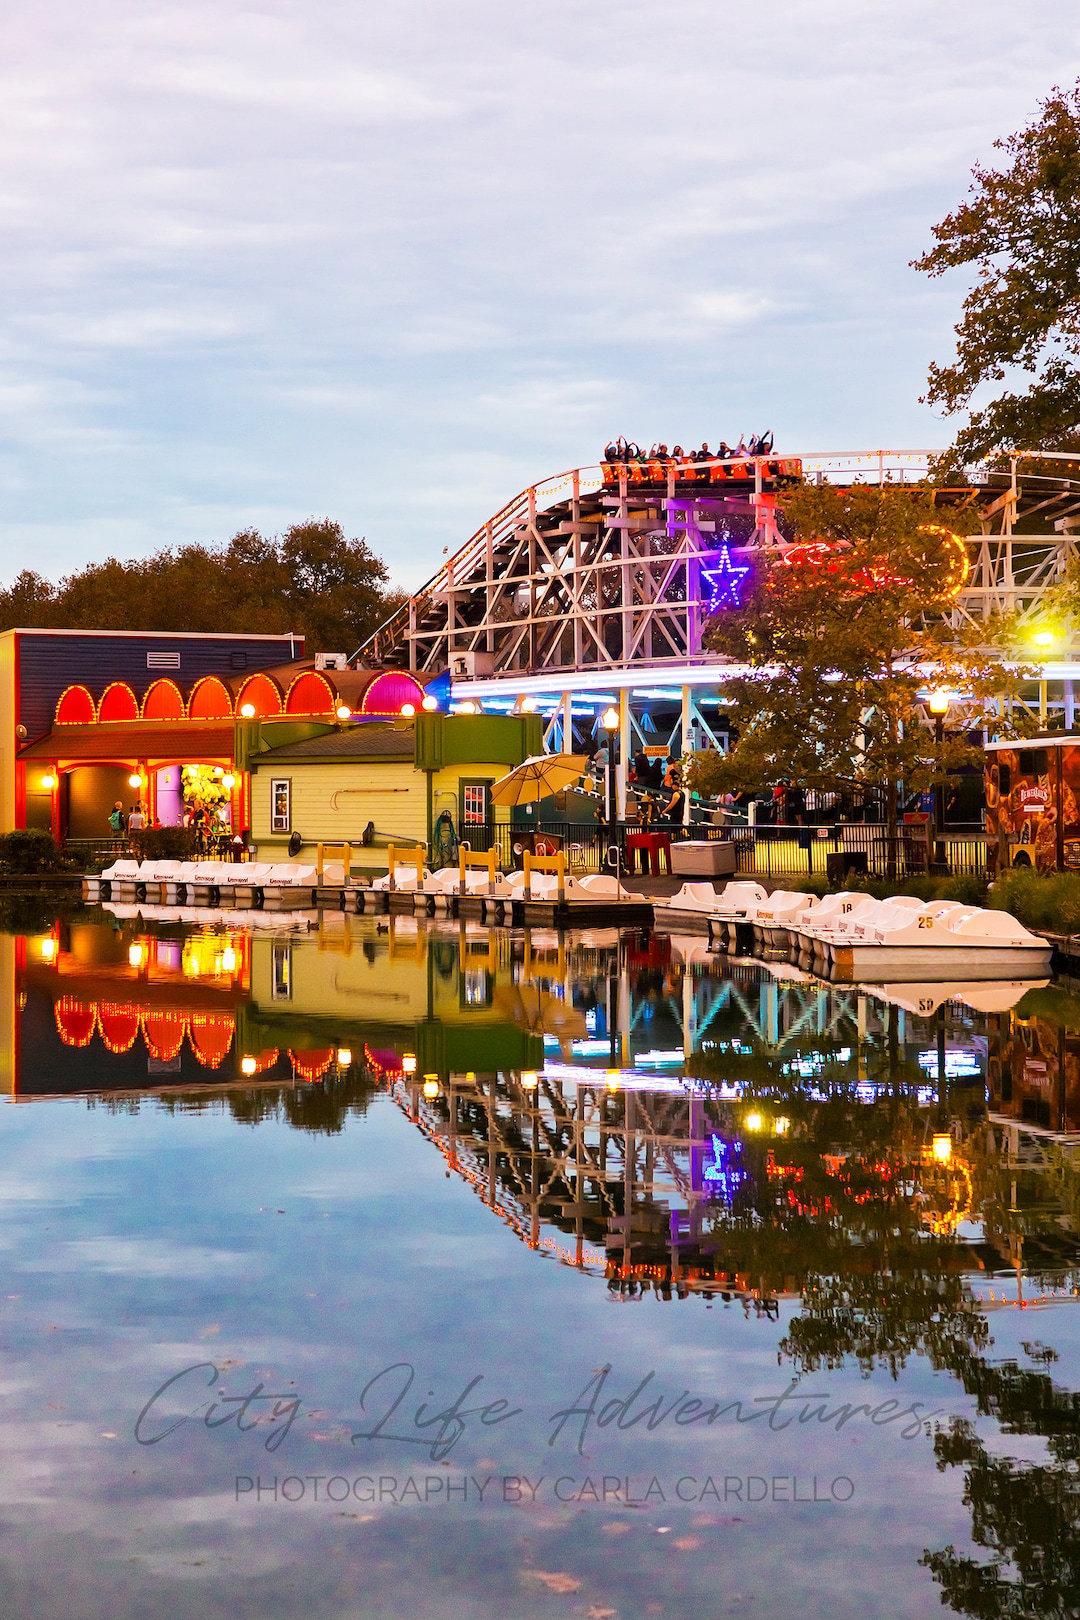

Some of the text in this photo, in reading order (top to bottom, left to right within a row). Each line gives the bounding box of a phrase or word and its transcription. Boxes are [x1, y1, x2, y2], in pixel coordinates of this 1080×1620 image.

[494, 875, 503, 884] 19
[568, 879, 573, 888] 4
[807, 897, 813, 908] 7
[841, 903, 853, 914] 18
[918, 916, 934, 929] 25
